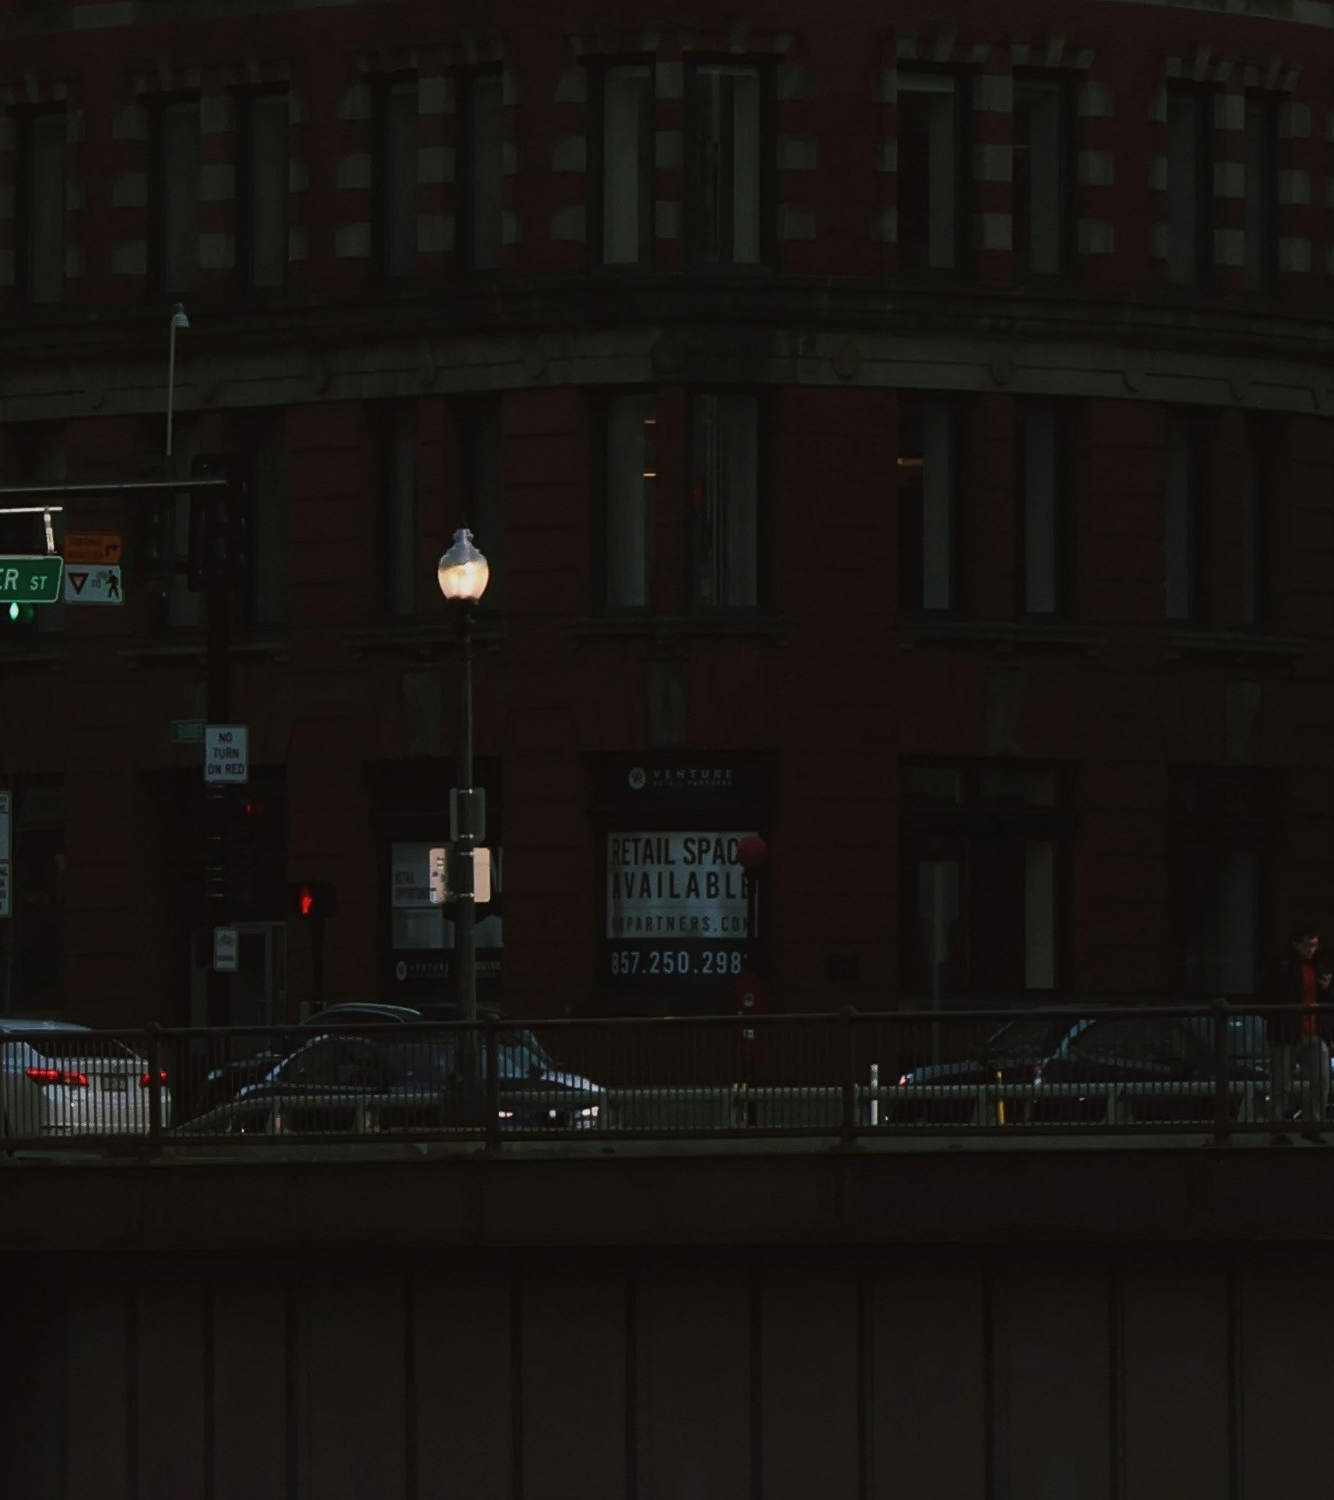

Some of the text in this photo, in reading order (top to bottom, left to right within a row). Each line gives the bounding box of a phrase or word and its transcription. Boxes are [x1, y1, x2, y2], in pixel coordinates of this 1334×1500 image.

[30, 575, 48, 591] ST
[218, 732, 233, 743] NO
[213, 747, 240, 759] TURN
[207, 763, 245, 775] ON RED
[612, 837, 740, 865] RETAIL SPAC
[612, 871, 748, 899] AVAILABLE
[611, 950, 747, 975] 857.250.298
